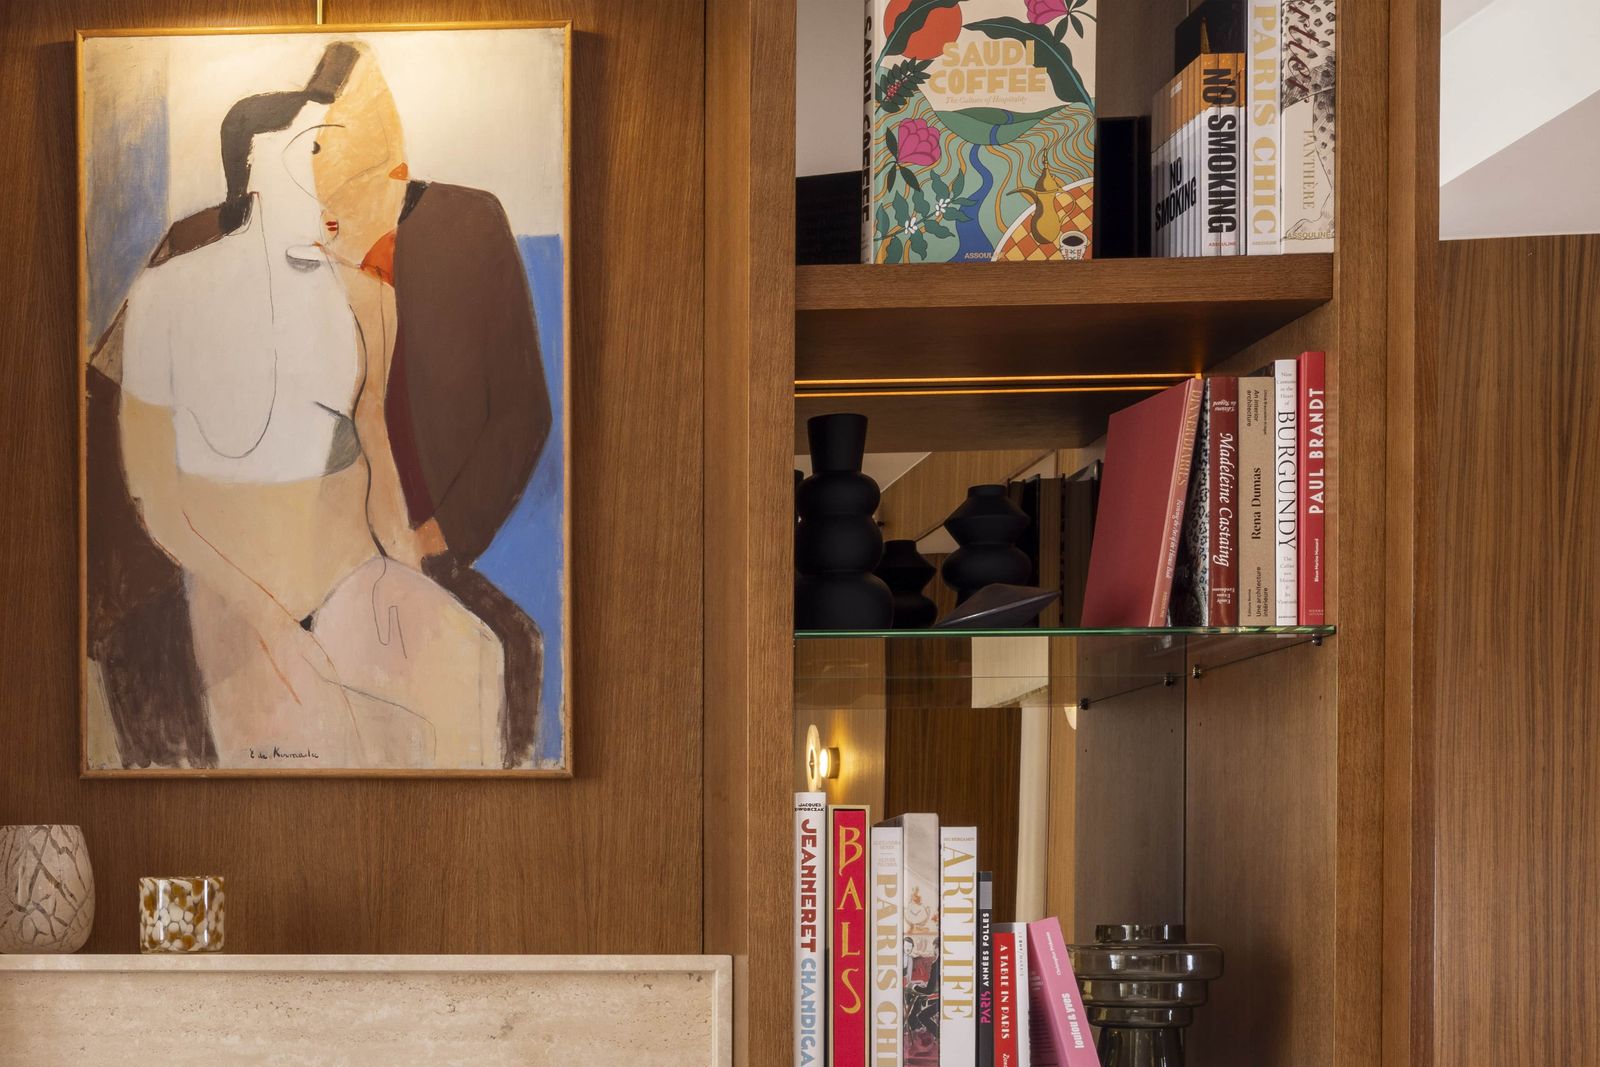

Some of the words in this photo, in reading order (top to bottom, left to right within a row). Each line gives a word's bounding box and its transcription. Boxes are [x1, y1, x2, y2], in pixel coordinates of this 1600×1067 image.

[943, 39, 1035, 67] SAUDI
[1253, 4, 1277, 127] PARIS
[928, 67, 1048, 95] COFFEE
[1202, 68, 1237, 105] NO
[1170, 157, 1183, 191] NO
[1207, 114, 1237, 233] SMOKING
[1252, 136, 1277, 234] CHIC
[1155, 176, 1196, 232] SMOKING
[1287, 231, 1331, 239] ASSOULINE
[1309, 388, 1324, 459] BRANDT
[1219, 433, 1236, 504] Madeleine
[1252, 467, 1262, 507] Dumas
[1277, 411, 1296, 549] BURGUNDY
[1309, 467, 1324, 515] PAUL
[1212, 507, 1234, 568] Castaing
[1252, 512, 1262, 540] Rena
[801, 818, 817, 953] JEANNERET
[837, 825, 863, 1014] BALS
[876, 874, 898, 991] PARIS
[982, 912, 990, 946] FOLLES
[1000, 944, 1008, 952] A
[981, 950, 990, 987] ANNÉES
[1000, 955, 1009, 987] TABLE
[980, 990, 991, 1024] PARIS
[1001, 990, 1009, 1003] IN
[1061, 992, 1076, 1014] yves
[1001, 1006, 1010, 1039] PARIS
